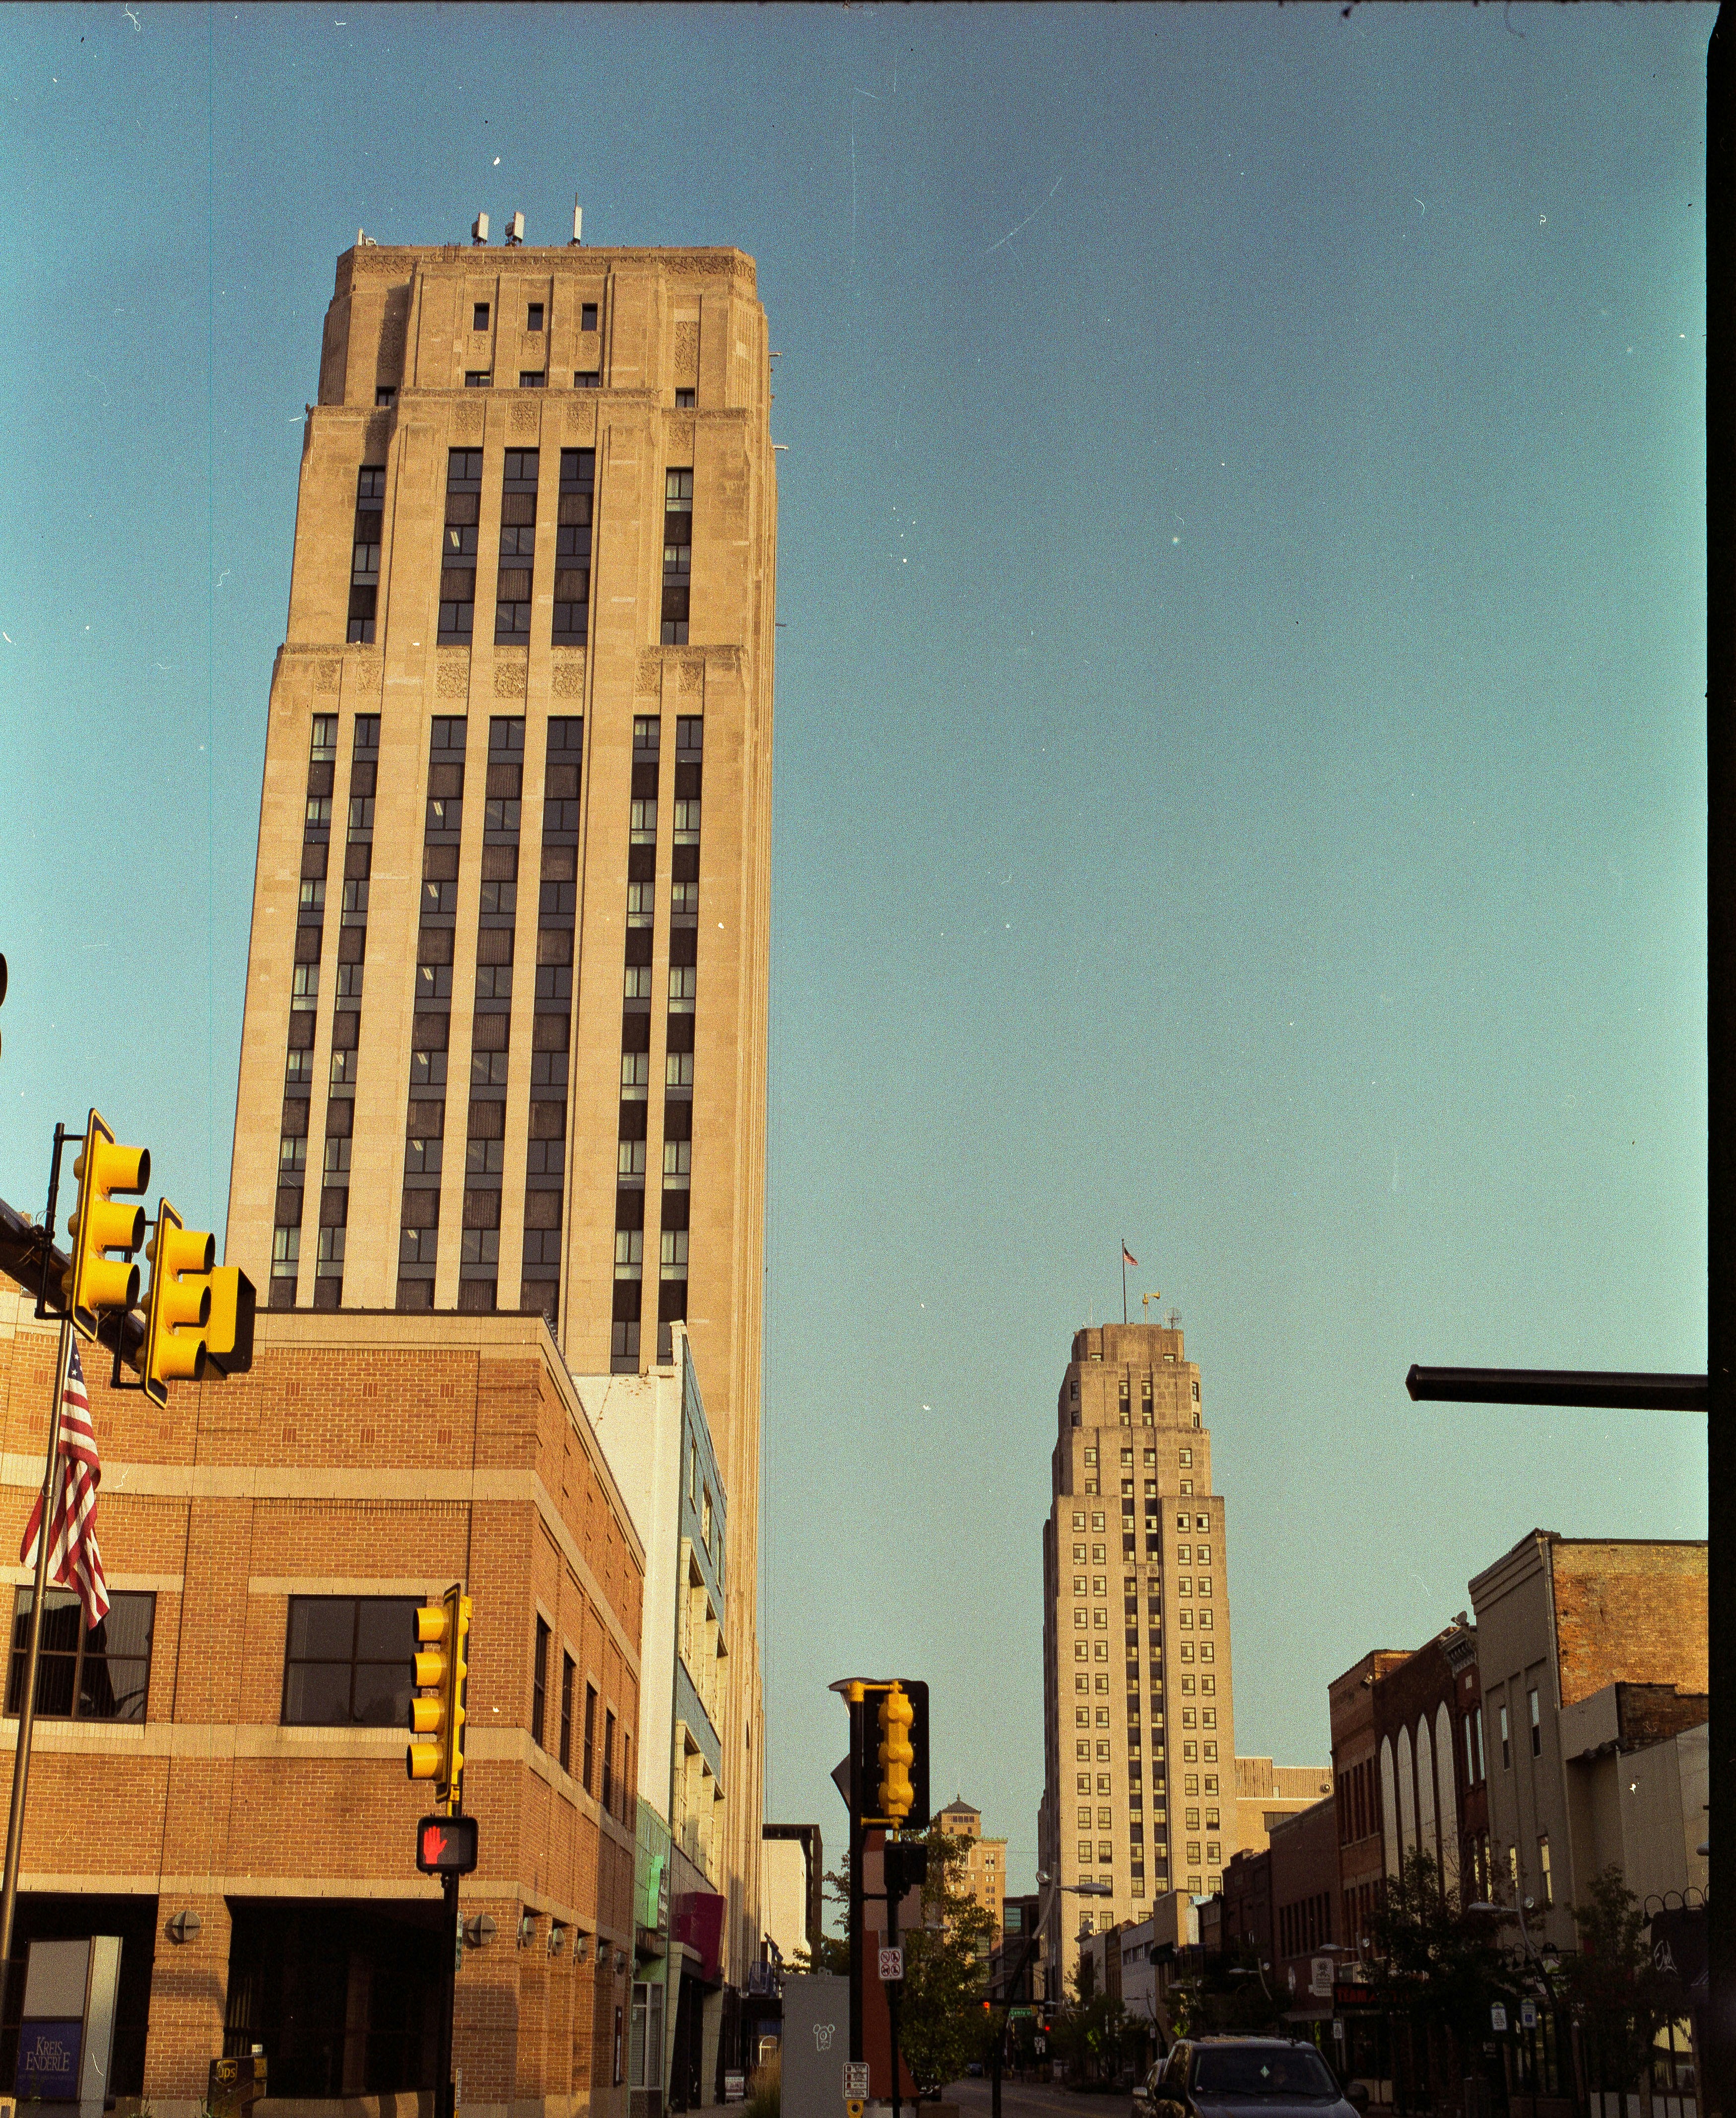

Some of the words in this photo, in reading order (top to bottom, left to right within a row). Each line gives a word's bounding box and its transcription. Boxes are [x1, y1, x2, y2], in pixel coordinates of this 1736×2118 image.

[1336, 1987, 1367, 2003] TEAM
[36, 2036, 63, 2055] KREIS
[26, 2052, 70, 2071] ENDERLE
